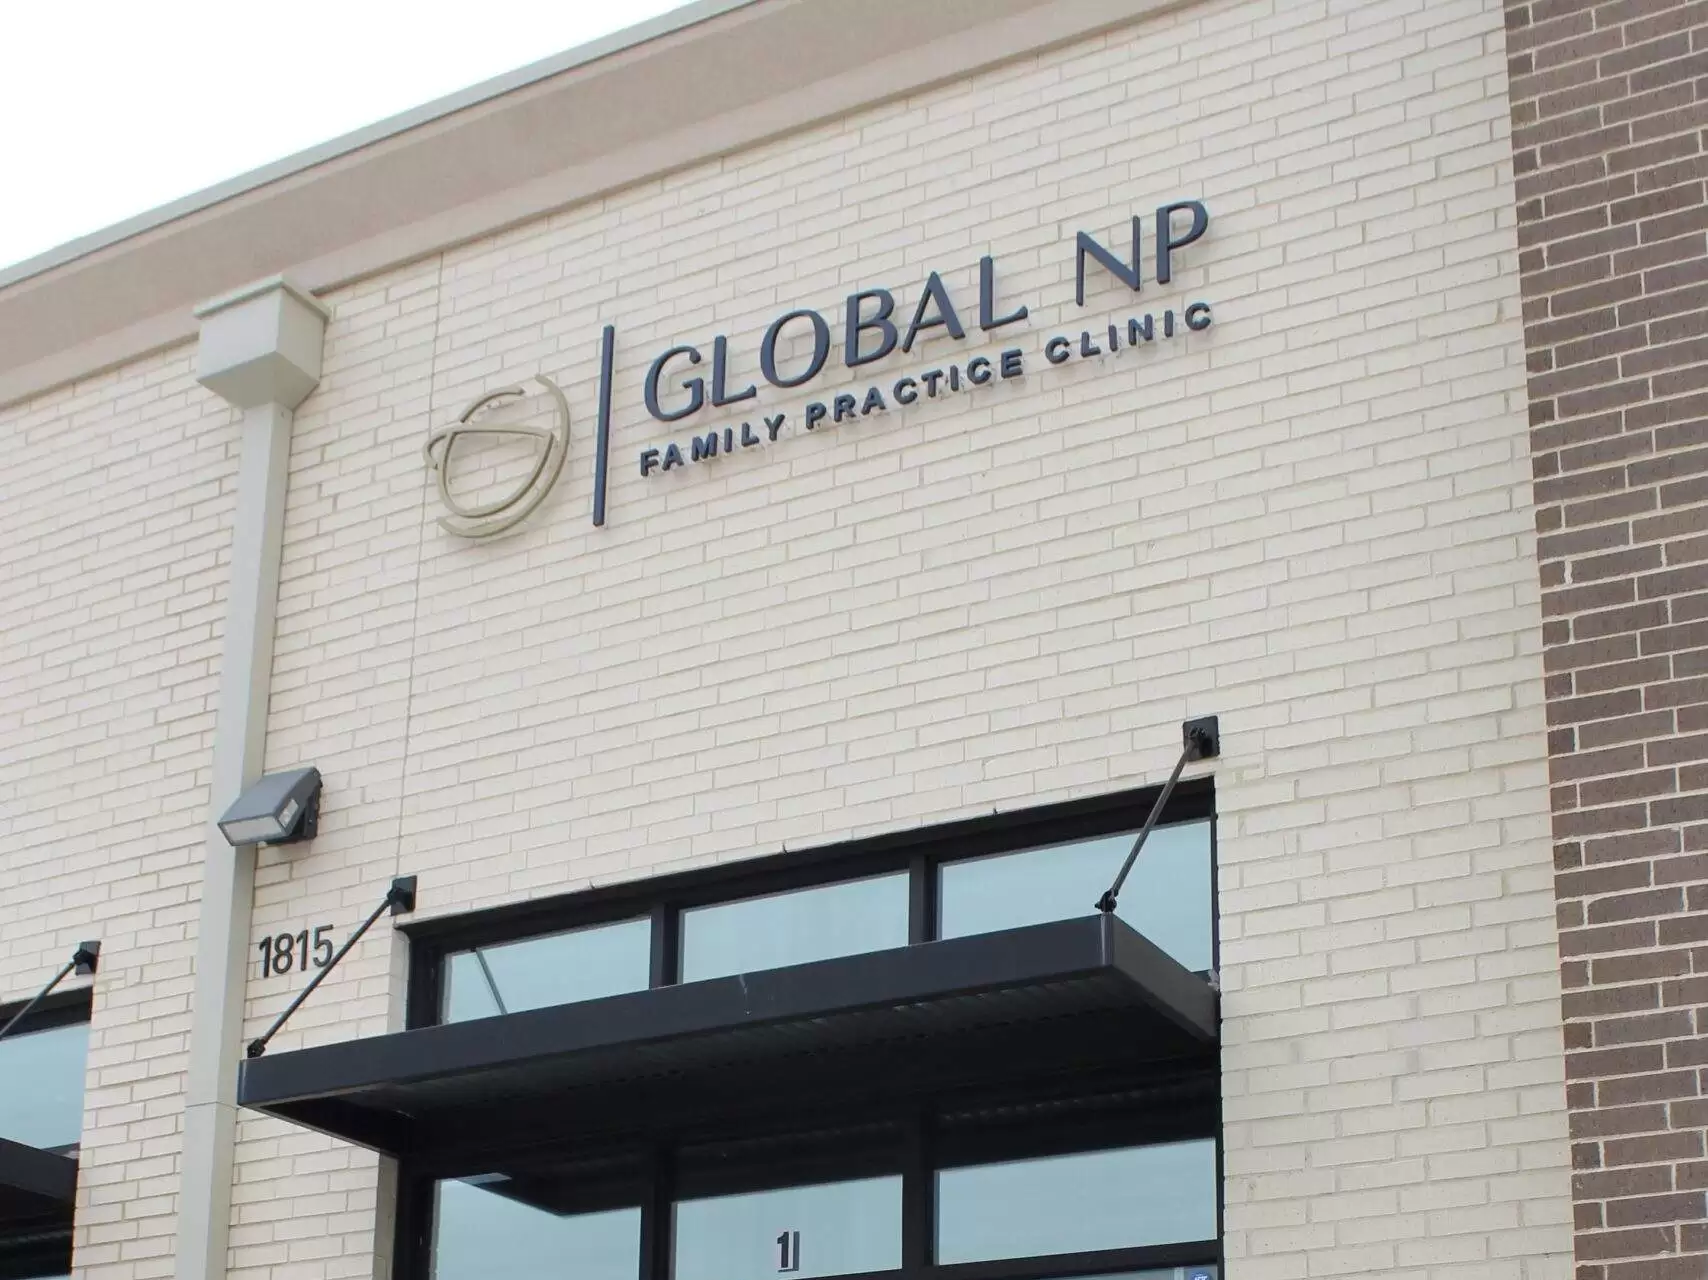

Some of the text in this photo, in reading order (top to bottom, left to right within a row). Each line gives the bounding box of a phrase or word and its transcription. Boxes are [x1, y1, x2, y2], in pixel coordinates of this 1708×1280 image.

[640, 302, 1212, 477] FAMILY PRACTICE CLINIC
[644, 200, 1209, 422] GLOBAL NP
[258, 924, 334, 978] 1815
